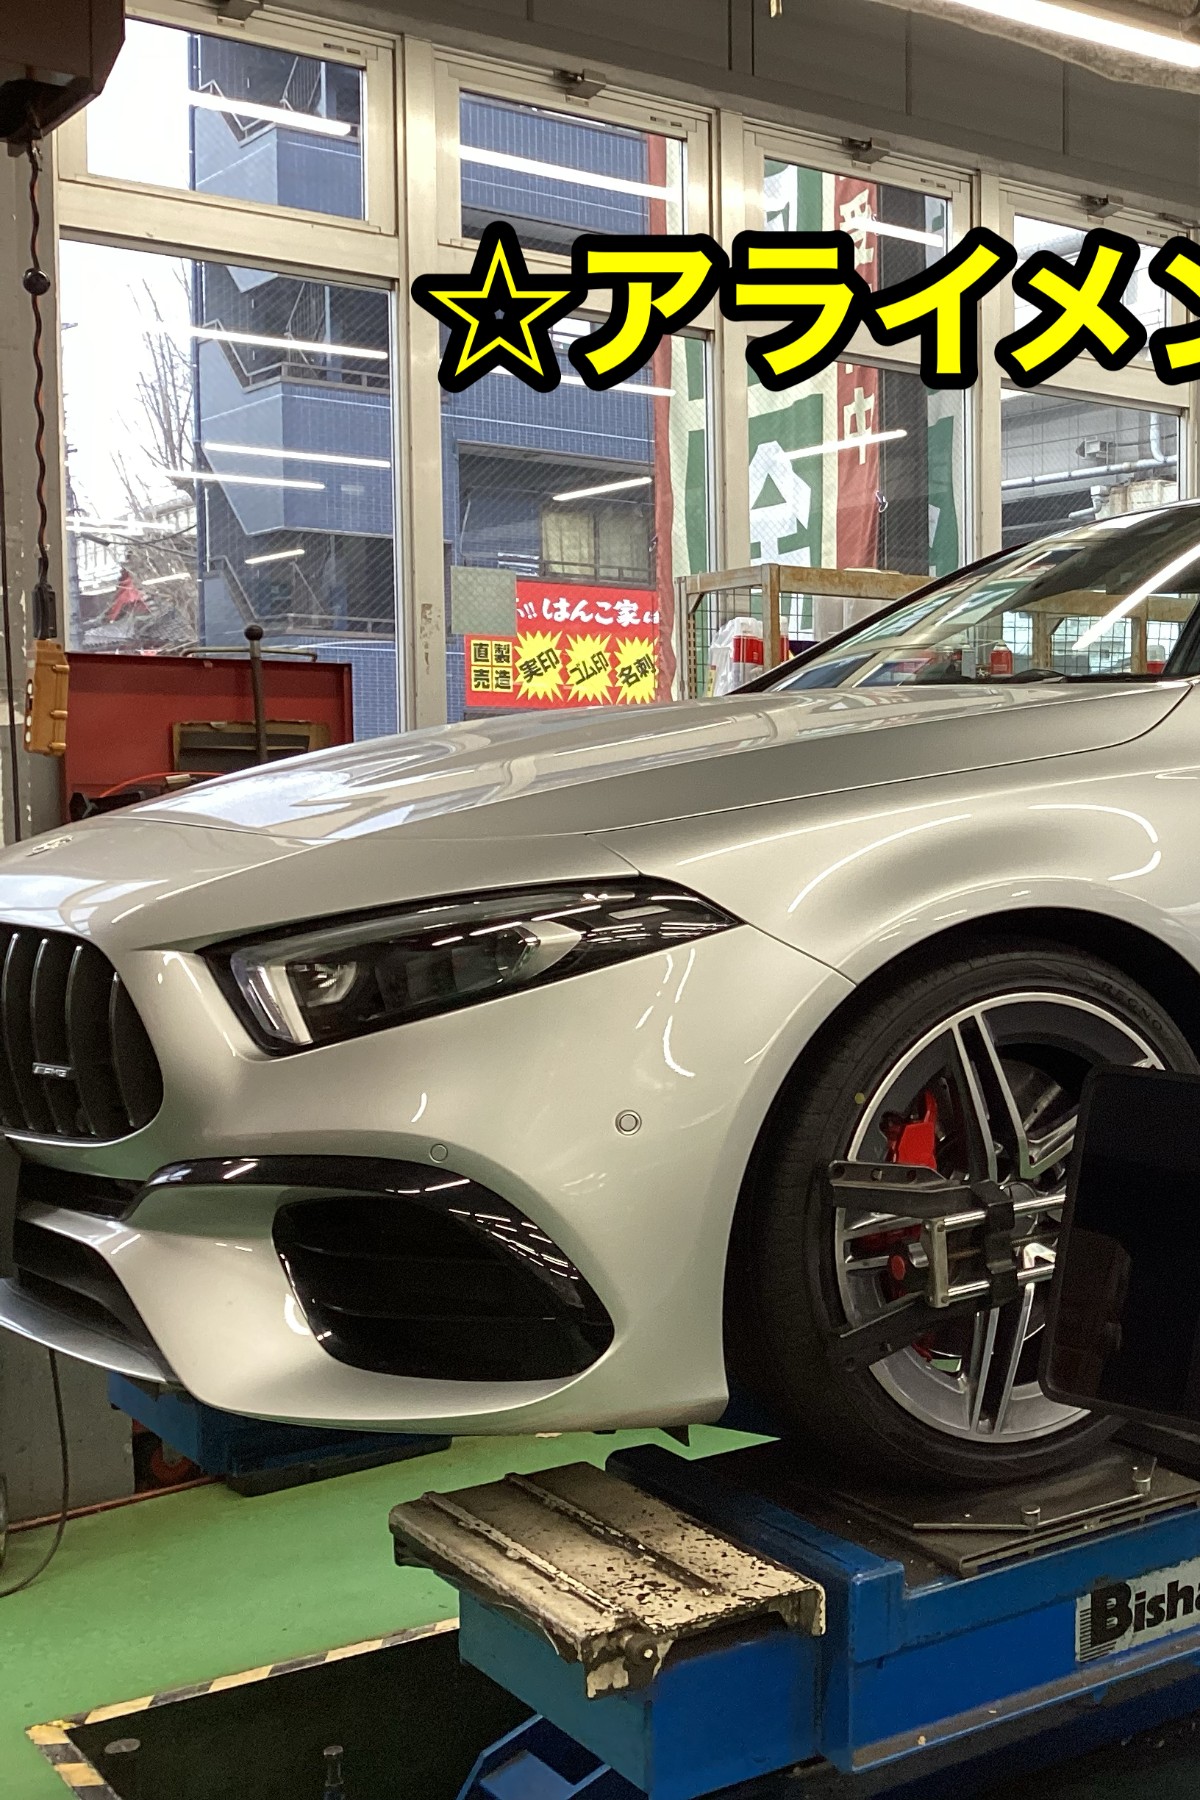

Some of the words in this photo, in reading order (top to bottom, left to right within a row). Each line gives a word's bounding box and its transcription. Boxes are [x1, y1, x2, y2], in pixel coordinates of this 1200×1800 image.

[518, 647, 561, 683] 実印
[569, 650, 610, 686] ゴム印
[618, 653, 657, 688] 名刺
